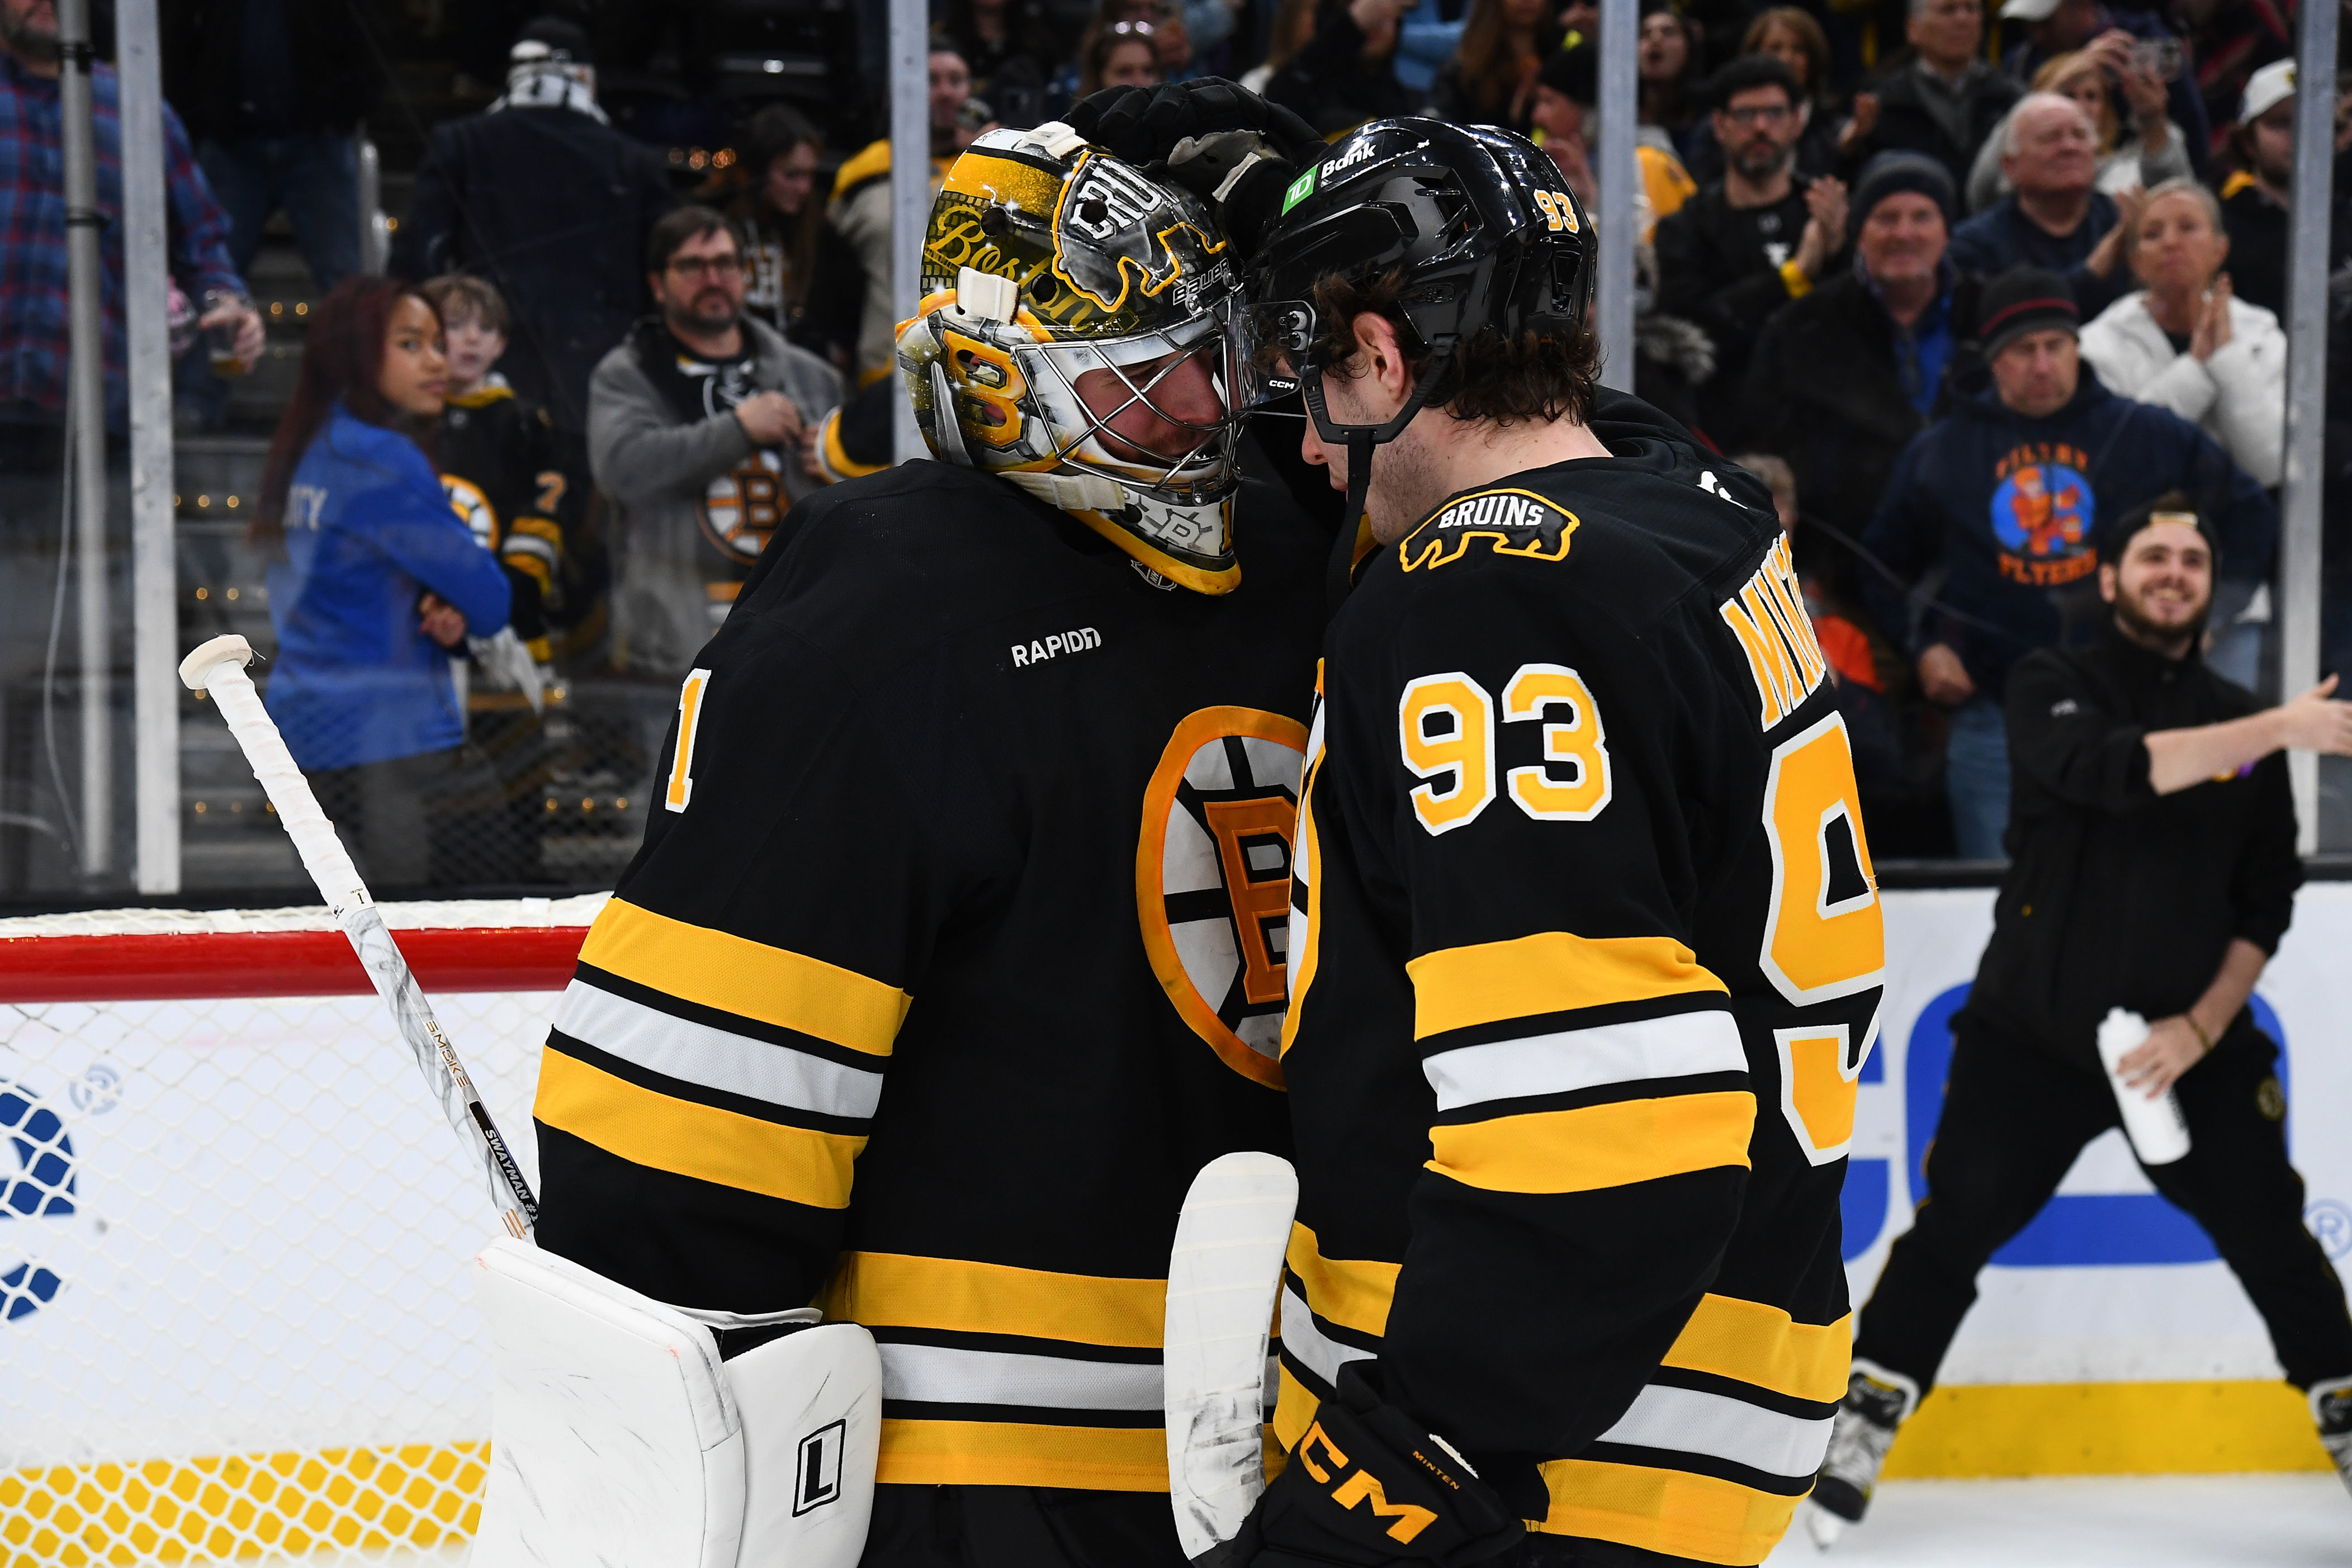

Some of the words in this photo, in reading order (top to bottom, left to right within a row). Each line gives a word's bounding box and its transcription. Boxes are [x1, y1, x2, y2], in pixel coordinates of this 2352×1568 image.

[1288, 174, 1312, 203] TD
[1321, 142, 1377, 179] Bank
[1533, 188, 1580, 234] 93
[1269, 380, 1295, 390] CCM
[1438, 495, 1545, 529] BRUINS
[1011, 627, 1101, 668] RAPID7
[665, 668, 712, 813] 1
[1399, 664, 1612, 836] 93
[1203, 795, 1300, 1005] B
[426, 1020, 470, 1088] SMOKE
[485, 1129, 529, 1200] SWAYMAN
[1412, 1450, 1460, 1490] MINTEN
